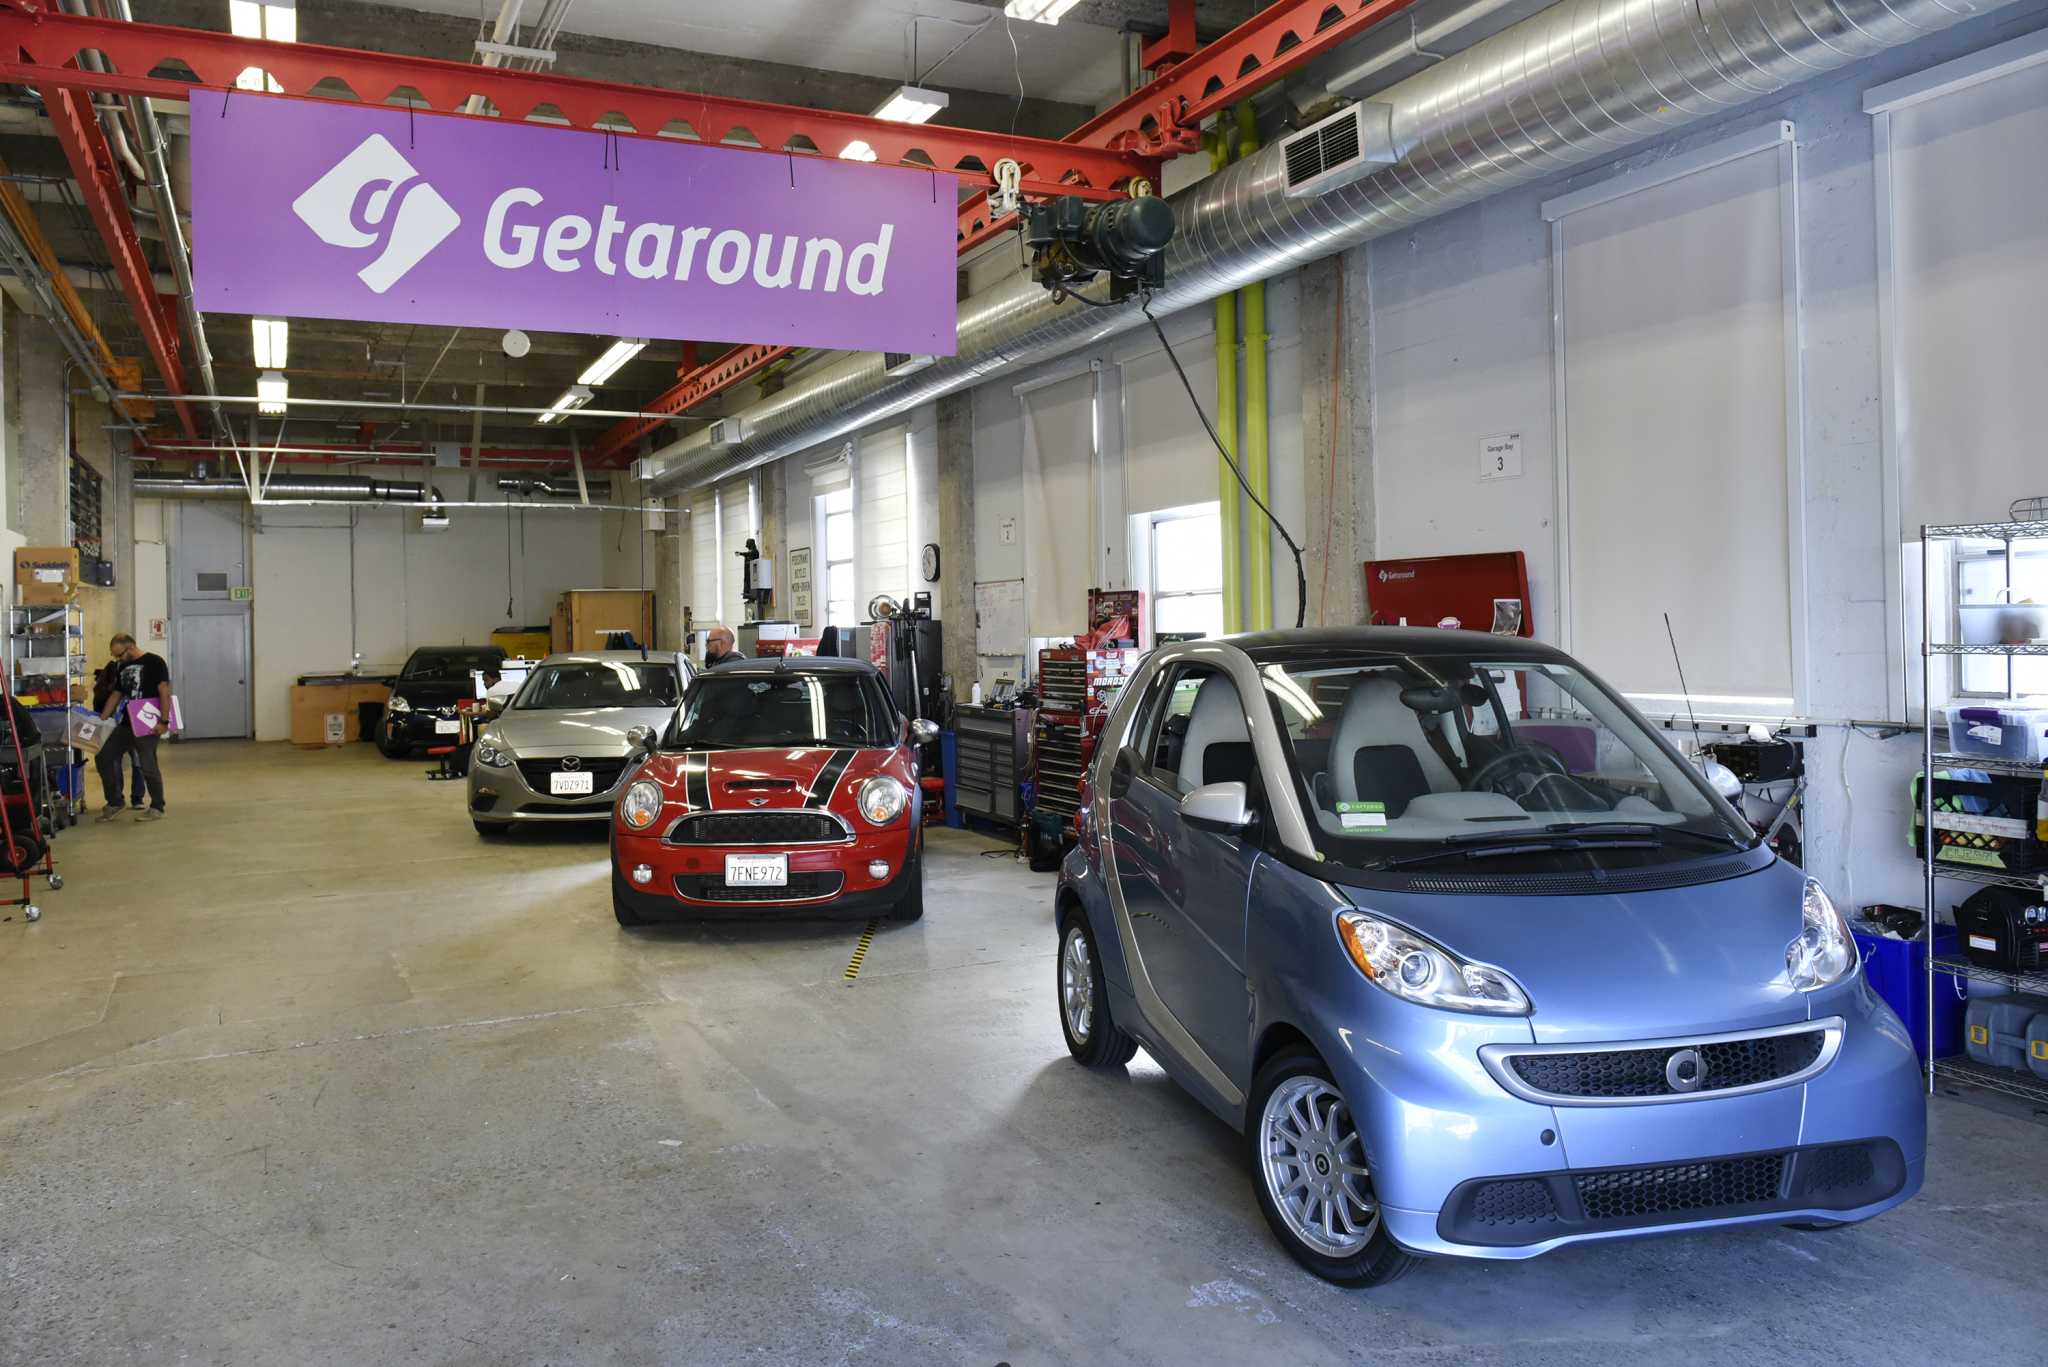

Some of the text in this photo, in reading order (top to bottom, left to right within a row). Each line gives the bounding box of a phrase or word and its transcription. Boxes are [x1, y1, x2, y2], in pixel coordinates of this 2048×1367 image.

[482, 187, 894, 297] Getaround
[1497, 456, 1504, 471] 3
[730, 866, 783, 881] 7FNE972
